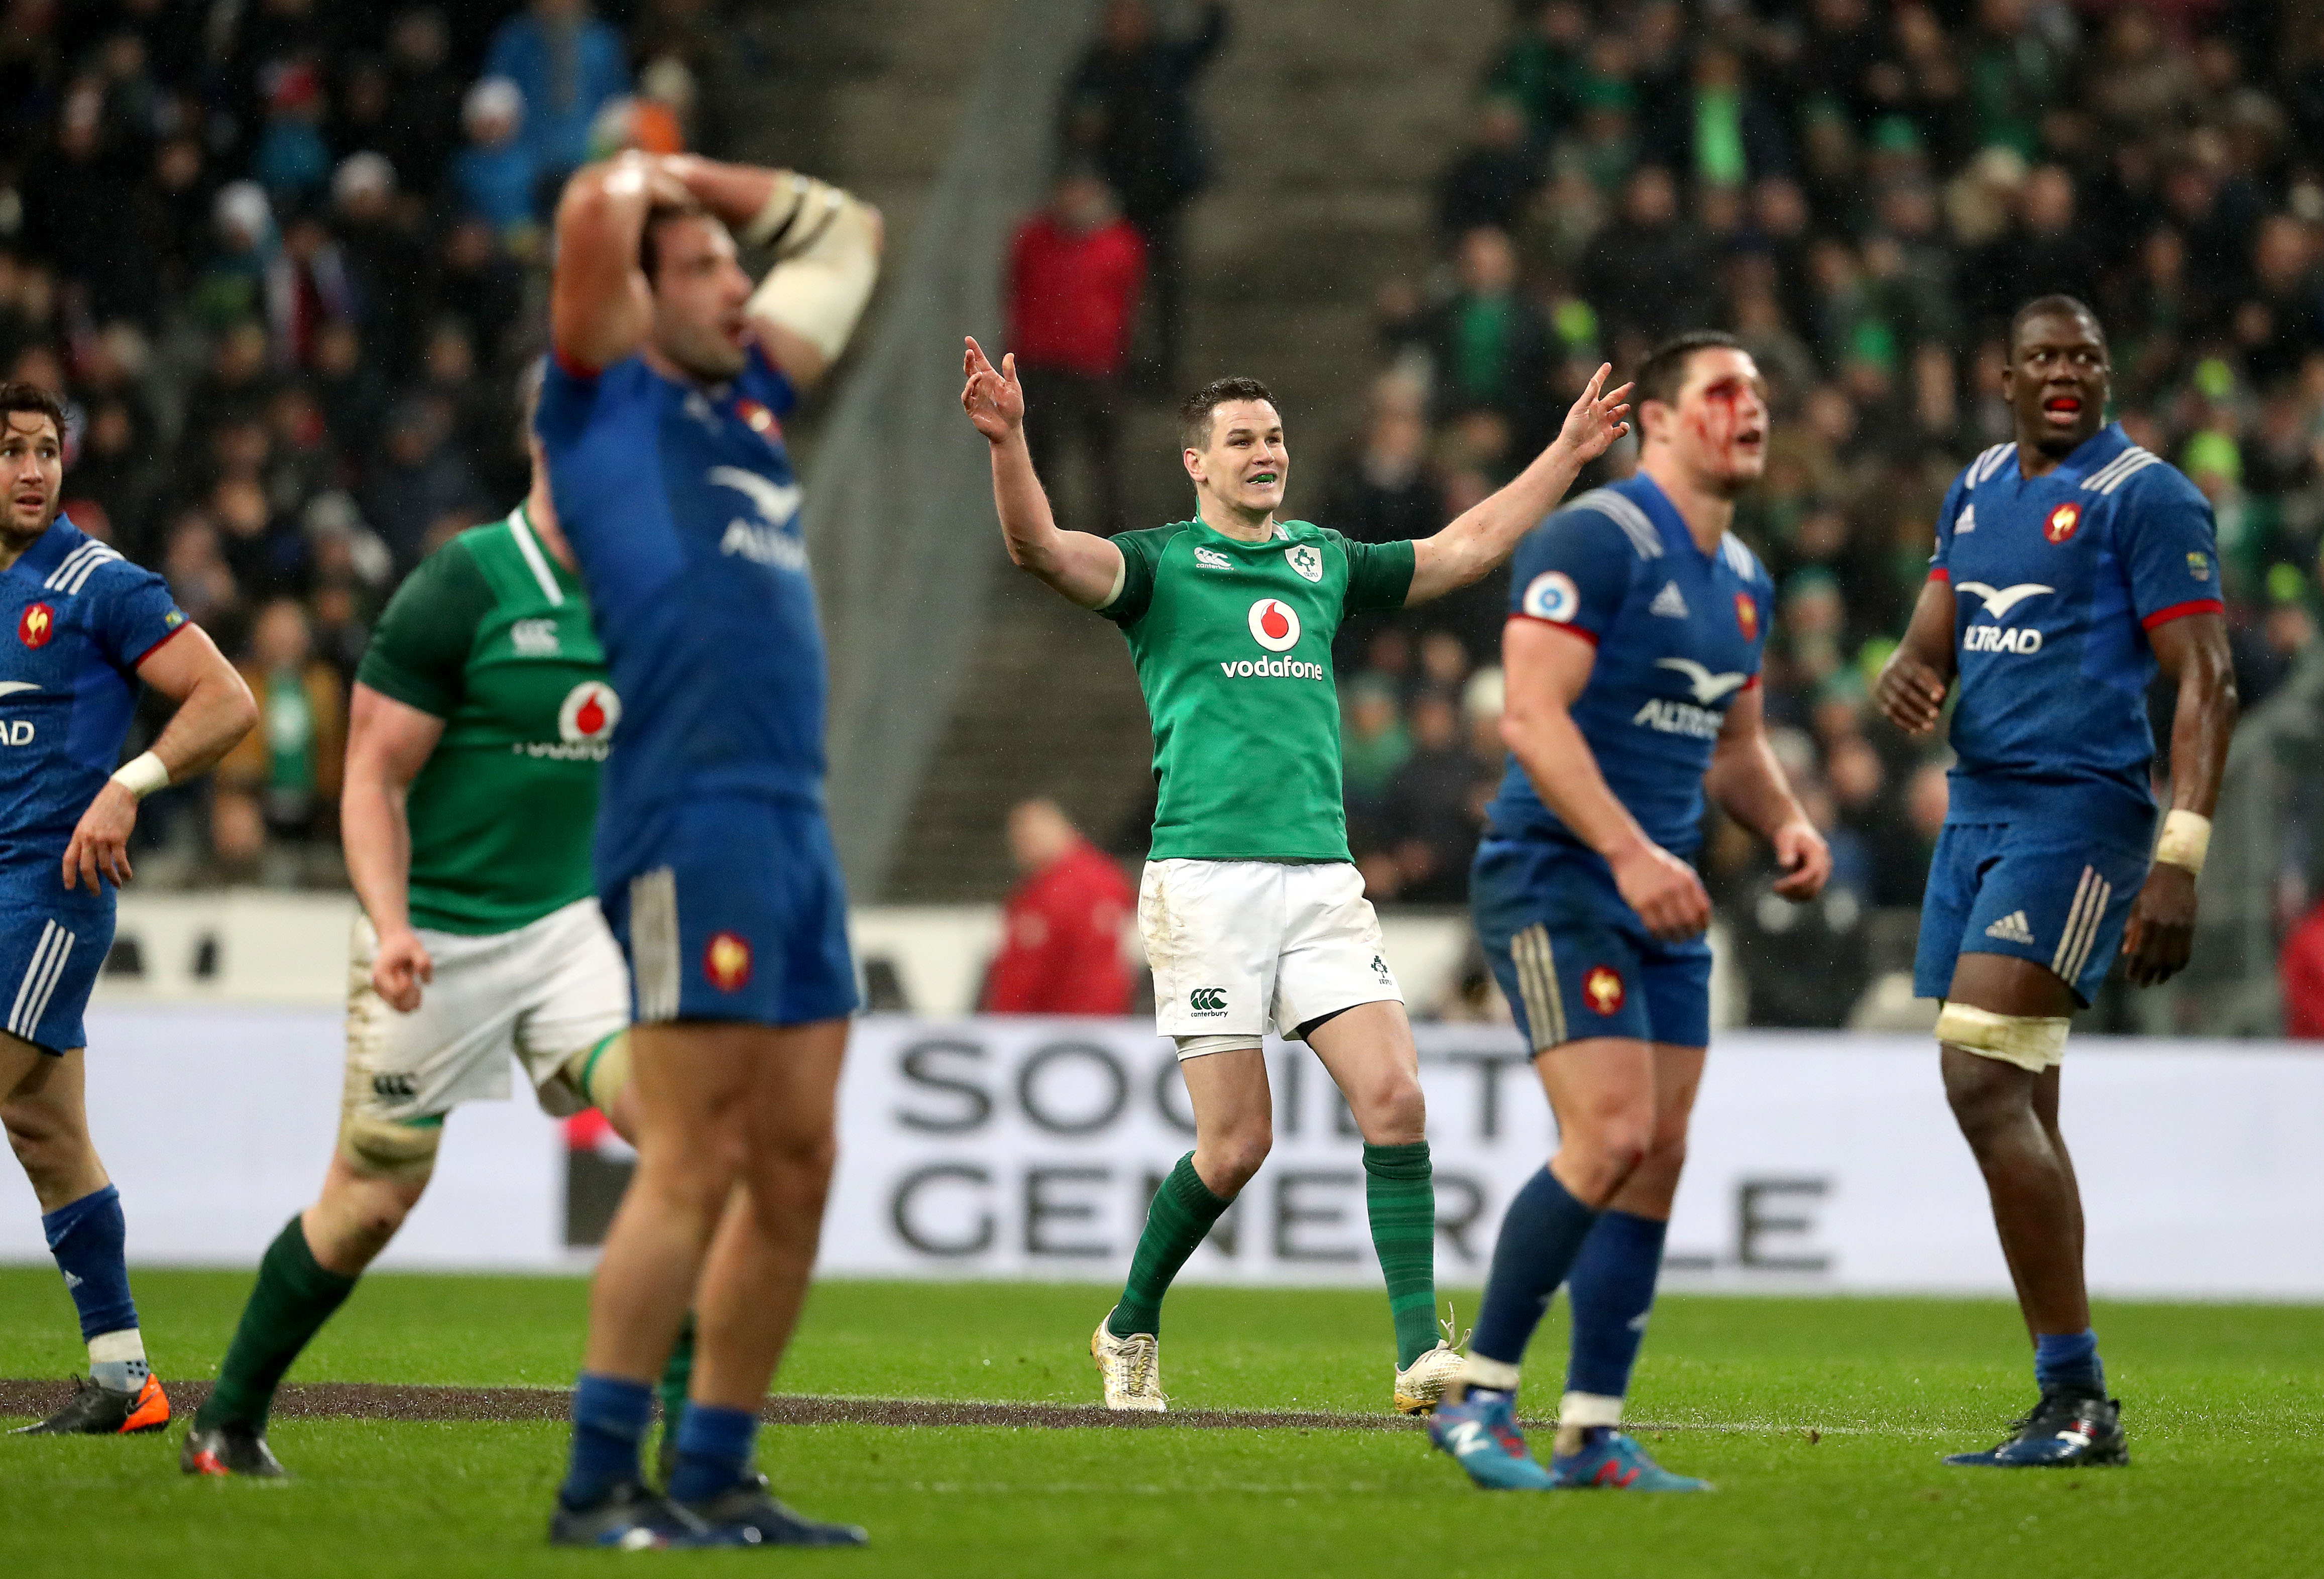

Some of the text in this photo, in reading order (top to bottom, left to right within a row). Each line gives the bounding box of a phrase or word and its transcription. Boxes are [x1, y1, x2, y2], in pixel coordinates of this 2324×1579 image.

[1963, 625, 2043, 654] LTRAD
[1220, 655, 1323, 681] vodafone
[891, 1164, 1832, 1270] GEERE
